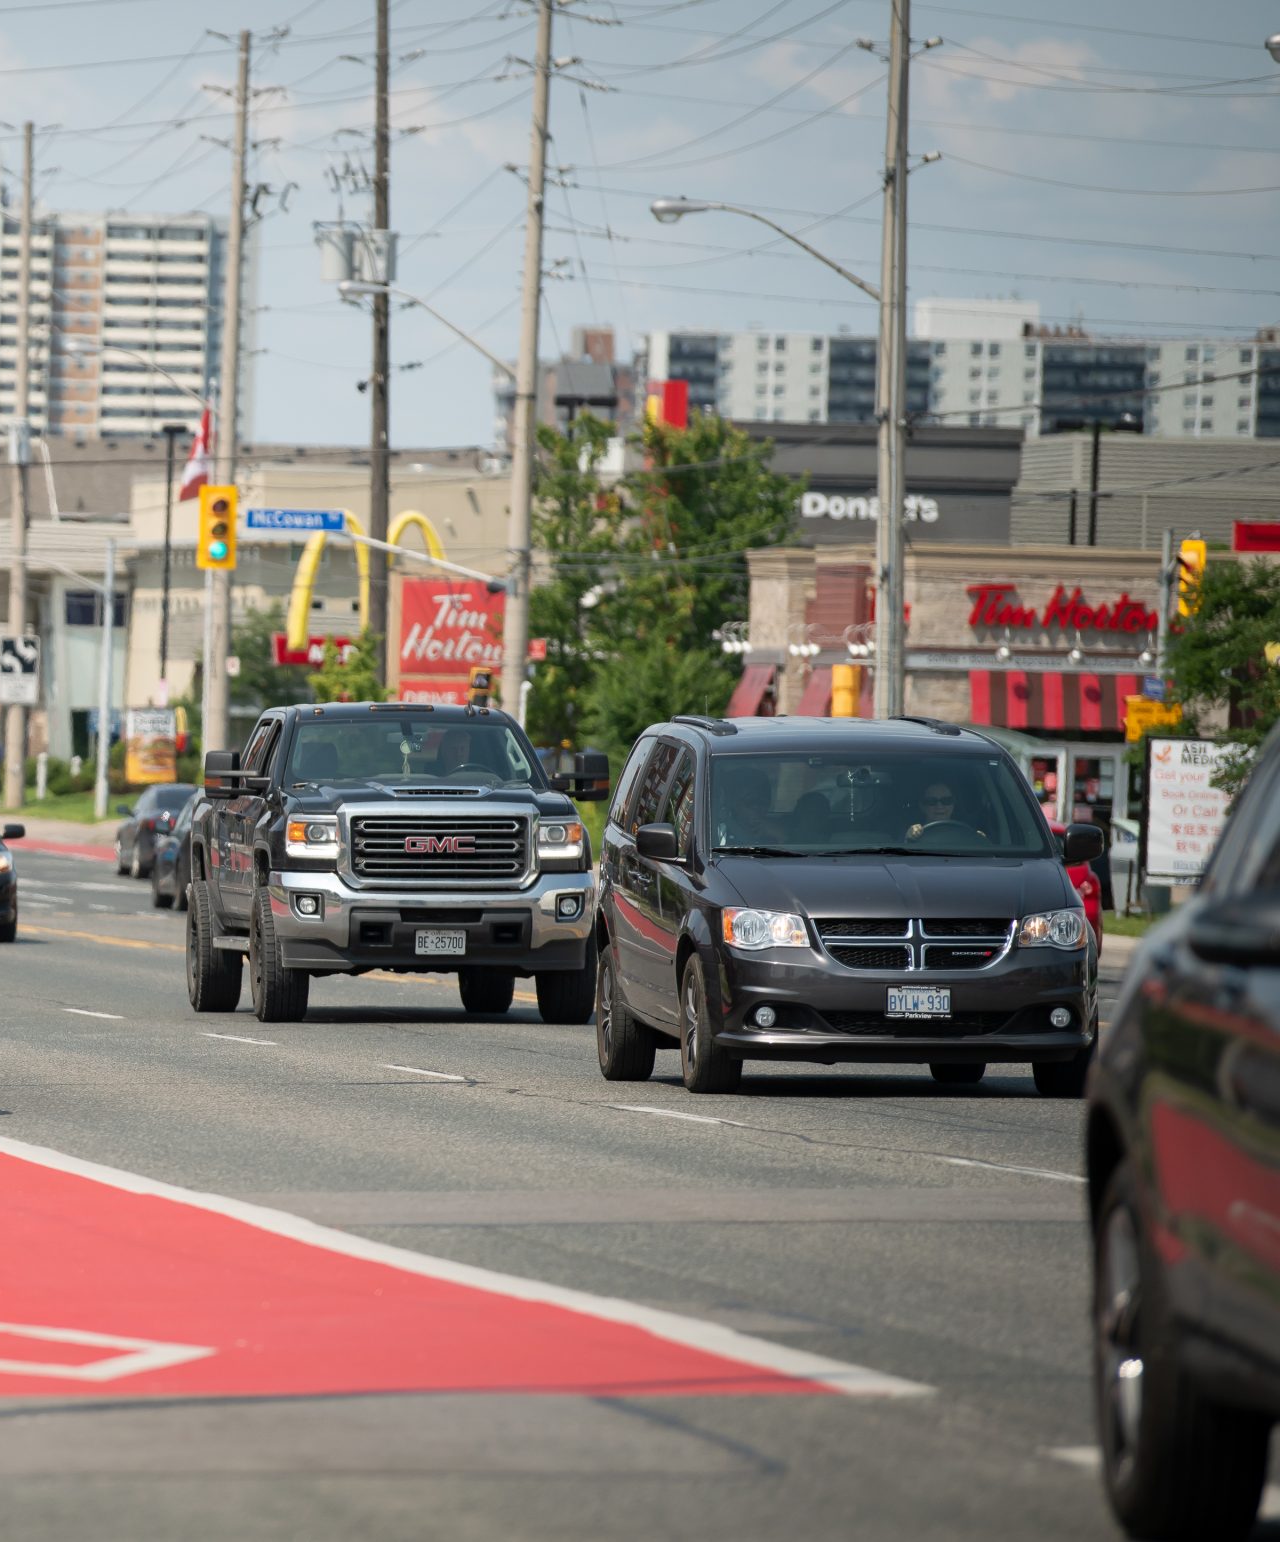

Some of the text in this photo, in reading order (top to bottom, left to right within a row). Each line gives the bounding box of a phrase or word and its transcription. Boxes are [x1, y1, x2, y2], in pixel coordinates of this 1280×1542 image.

[432, 593, 488, 630] Tim
[966, 581, 1184, 634] Tim Horton
[401, 622, 504, 663] Horton
[1182, 742, 1207, 754] ASH
[1172, 803, 1218, 818] Or Call
[404, 835, 476, 854] GMC
